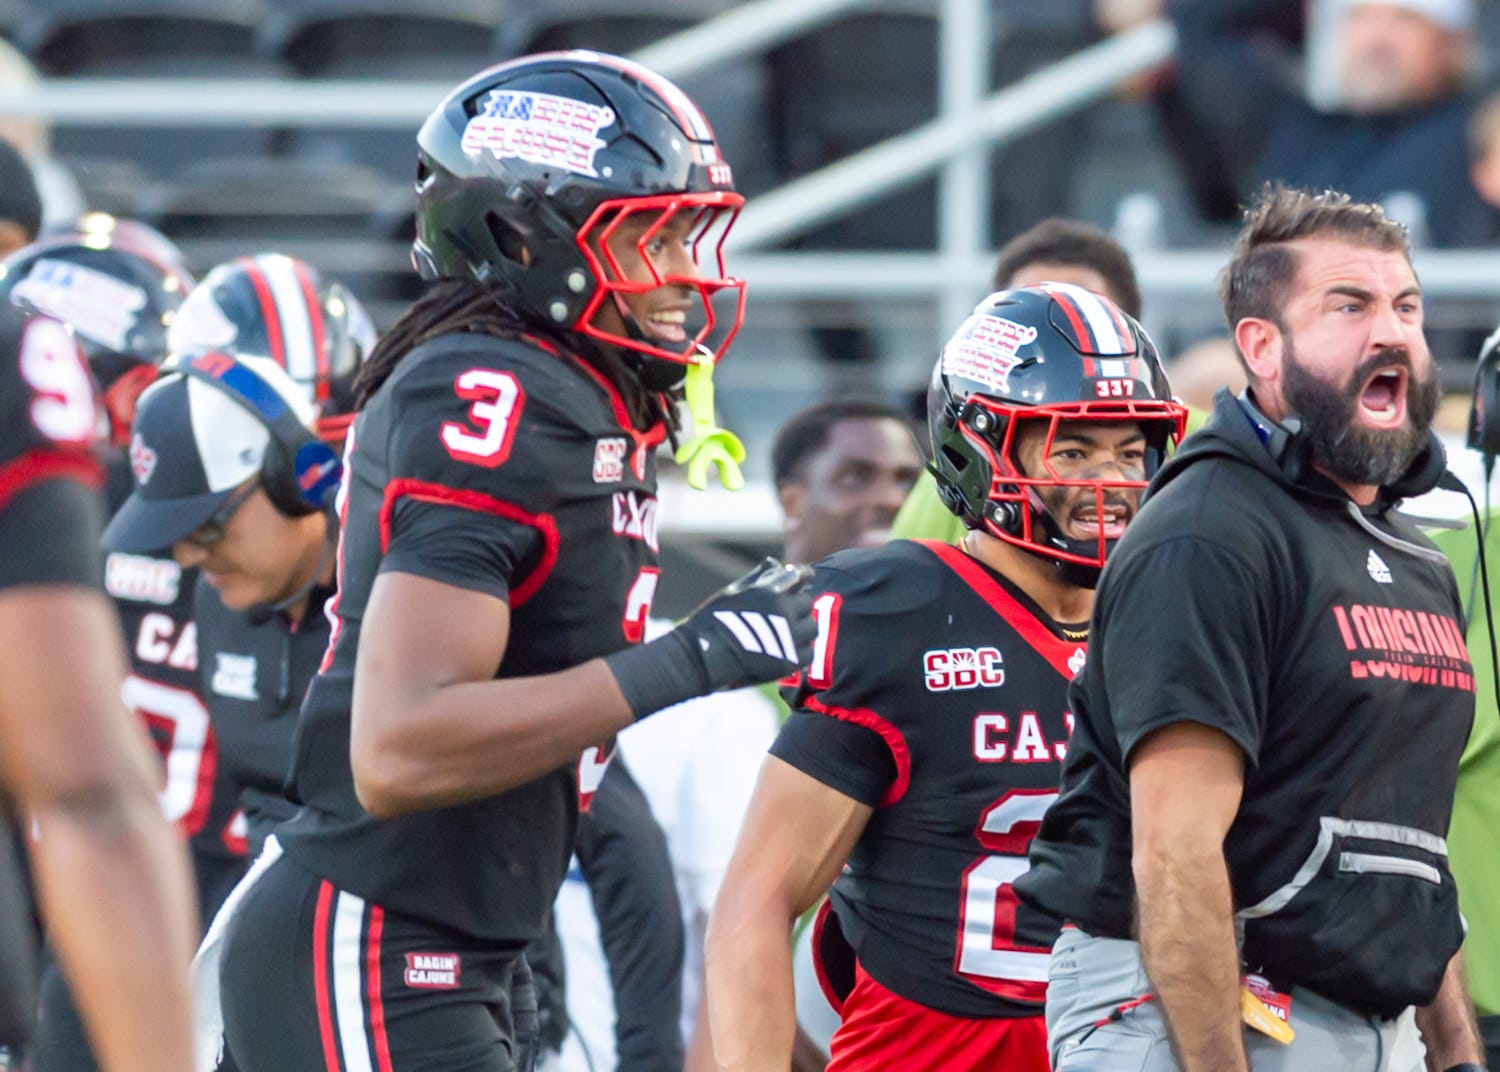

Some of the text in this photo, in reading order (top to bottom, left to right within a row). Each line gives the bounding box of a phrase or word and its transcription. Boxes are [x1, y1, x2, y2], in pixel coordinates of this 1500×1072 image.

[1096, 378, 1135, 397] 337
[439, 367, 526, 469] 3
[923, 646, 1005, 692] SBC
